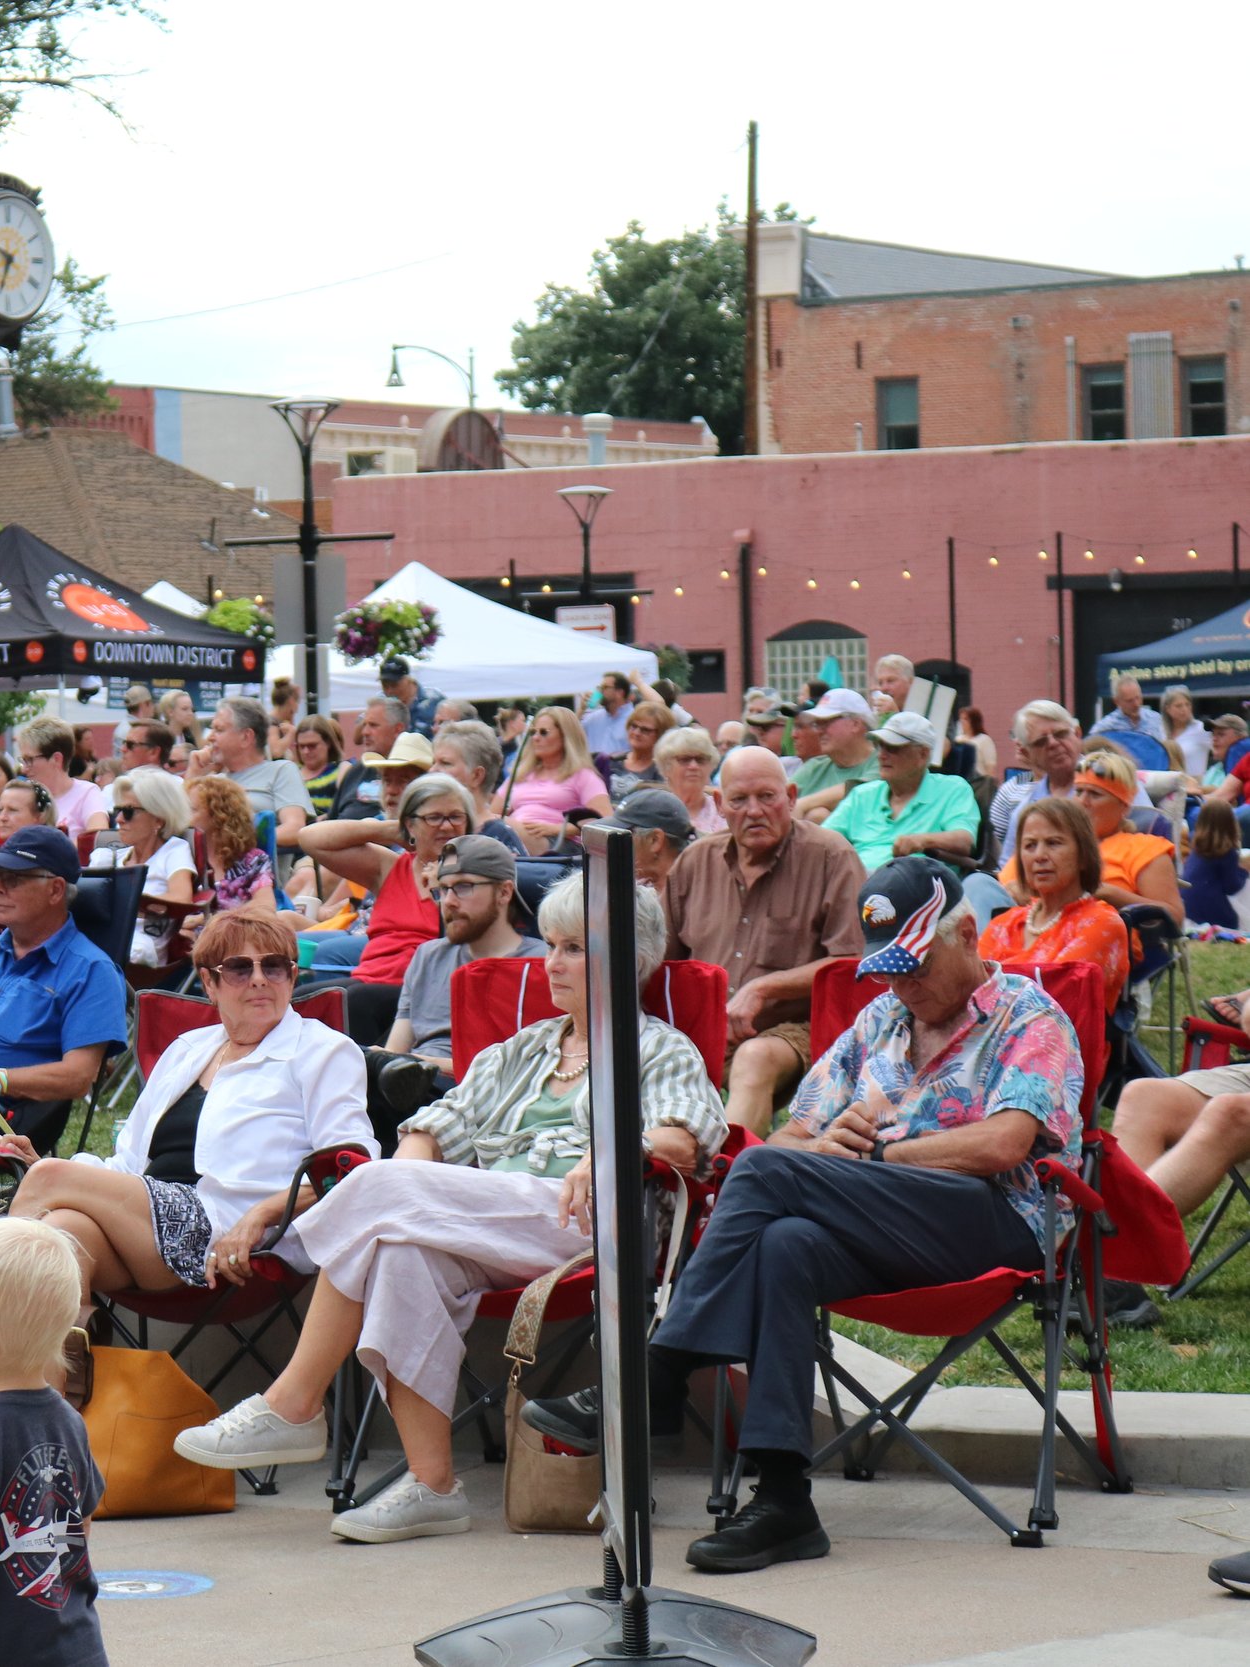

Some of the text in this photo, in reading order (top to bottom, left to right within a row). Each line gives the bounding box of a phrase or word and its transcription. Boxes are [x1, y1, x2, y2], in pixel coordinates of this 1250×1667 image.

[94, 641, 236, 669] DOWNTOWN DISTRICT
[1153, 664, 1187, 679] story
[1189, 659, 1215, 676] told
[1217, 658, 1233, 677] by
